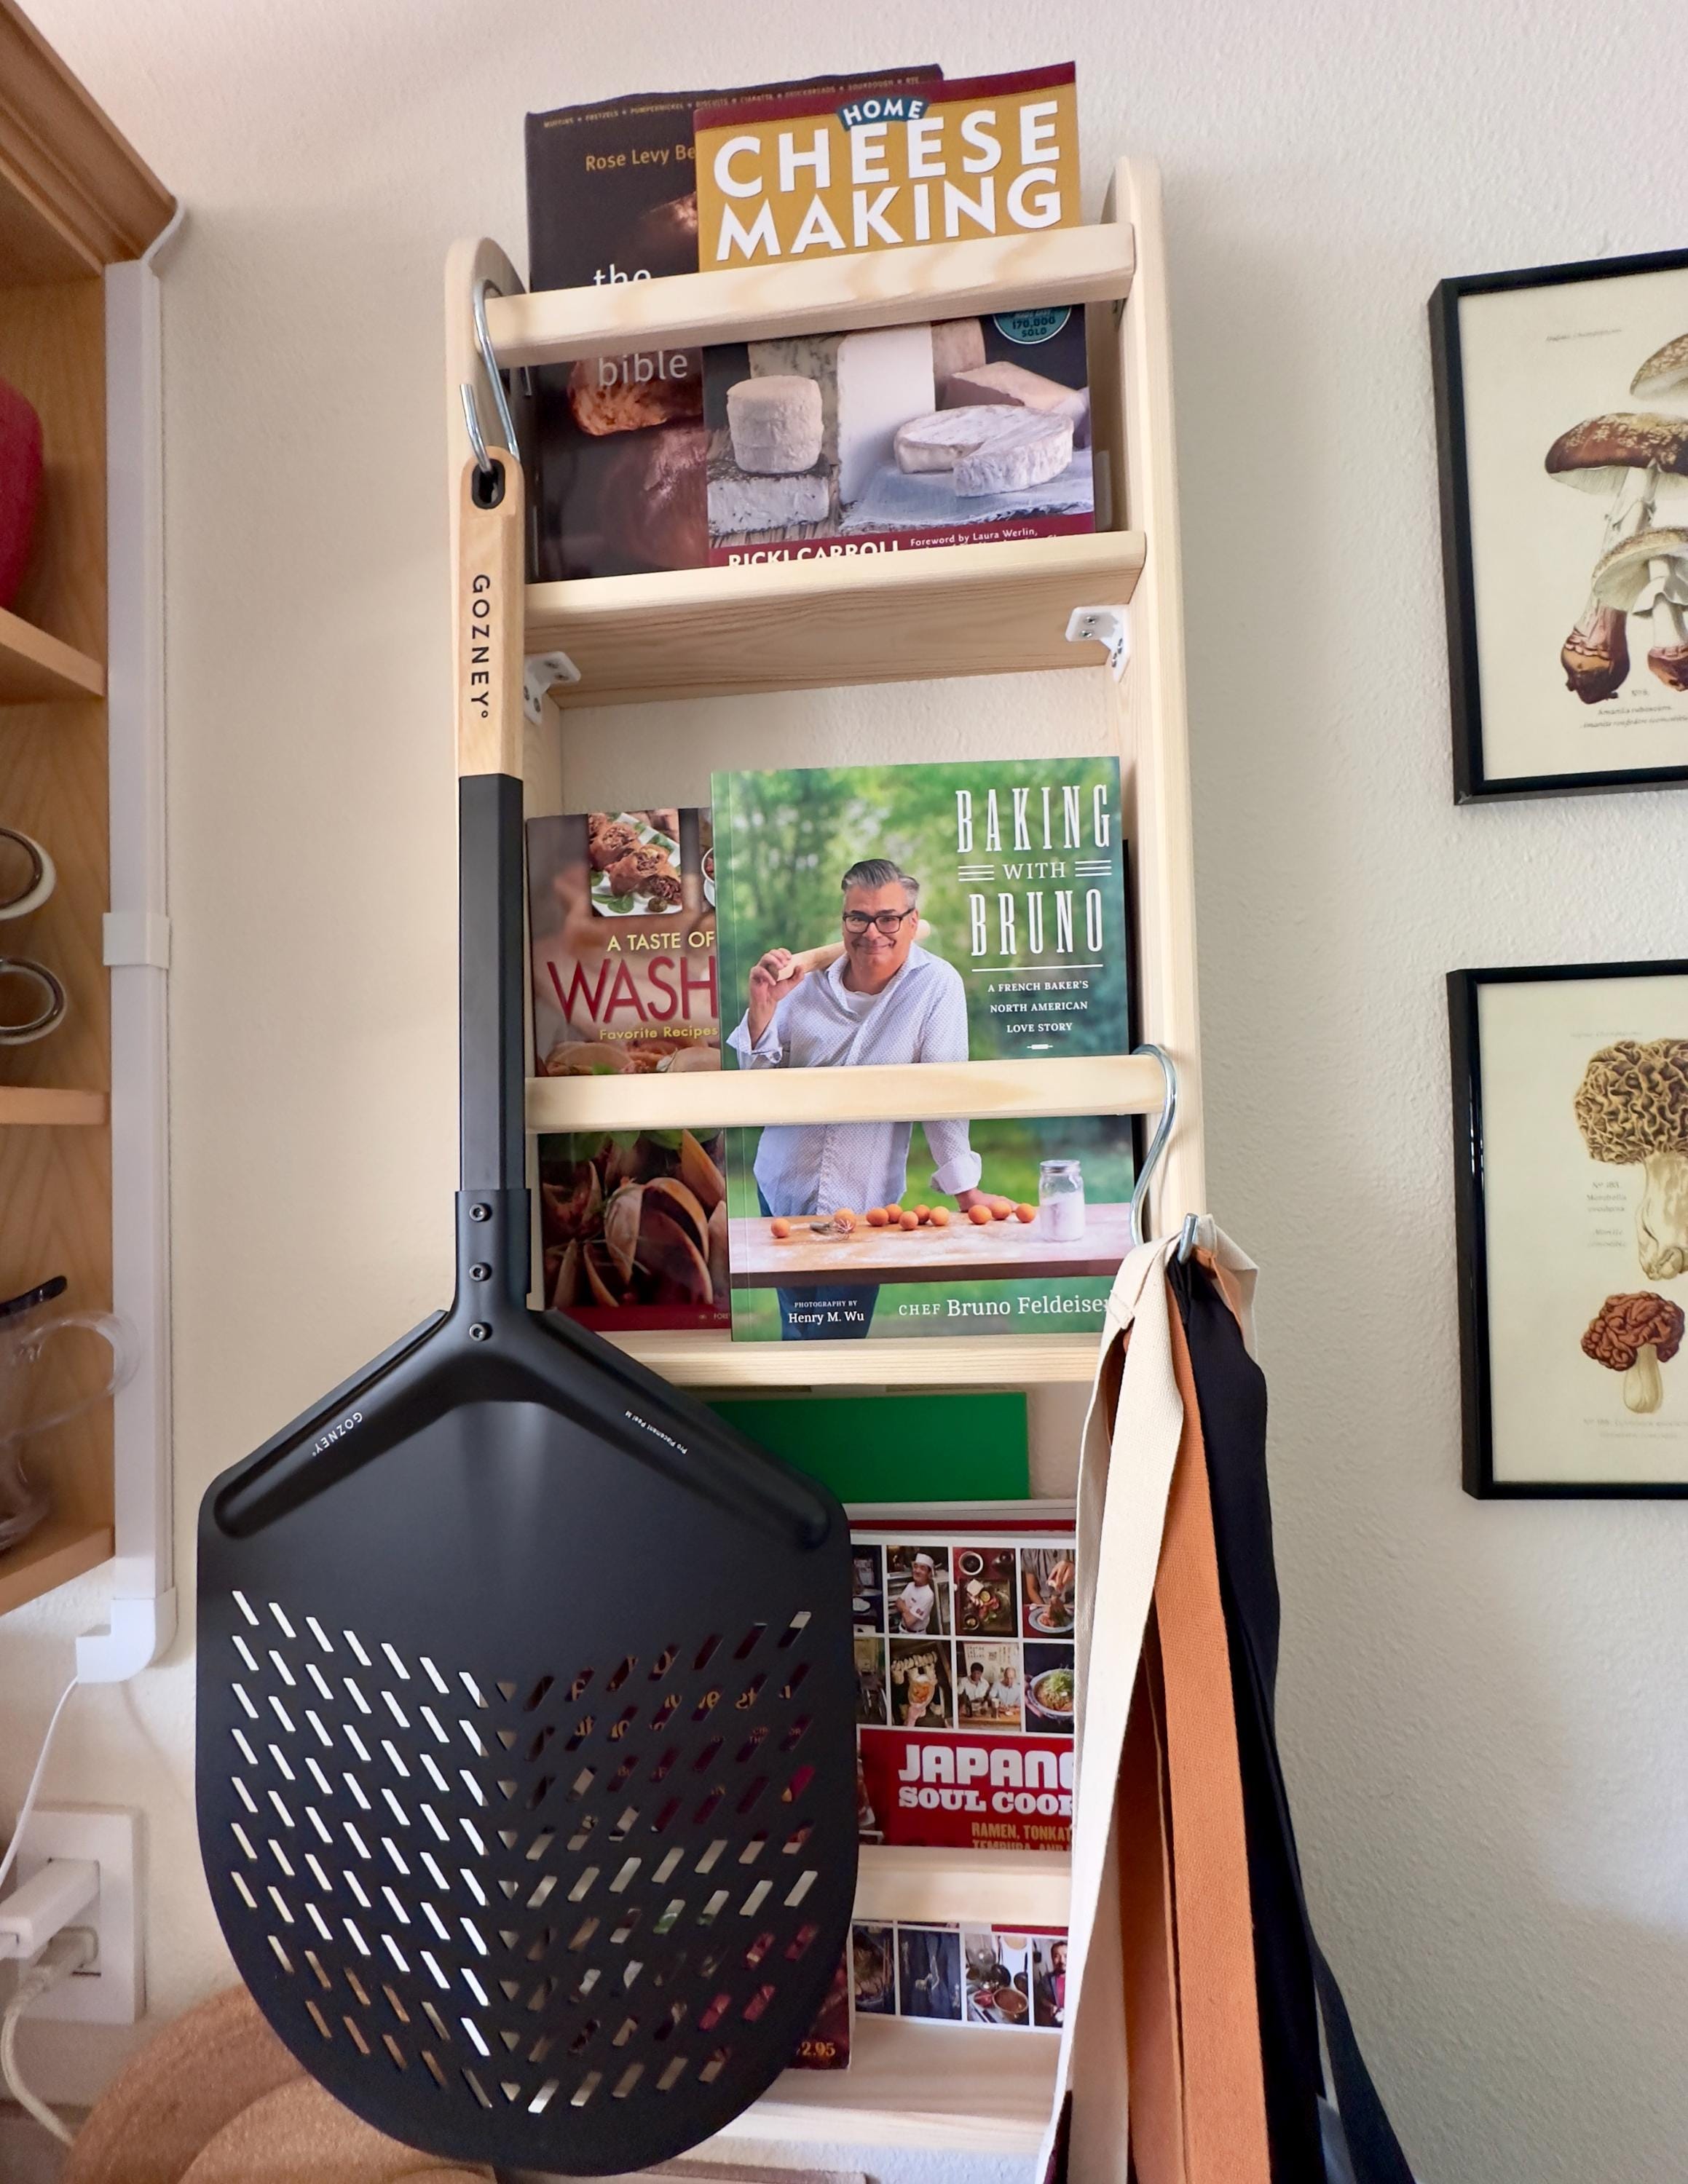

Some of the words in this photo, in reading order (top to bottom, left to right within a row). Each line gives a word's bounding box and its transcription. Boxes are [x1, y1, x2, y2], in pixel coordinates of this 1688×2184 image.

[843, 98, 923, 126] HOME
[713, 100, 1061, 199] CHEESE
[585, 154, 626, 172] Rose
[632, 148, 670, 165] Levy
[716, 167, 1062, 261] MAKING
[1012, 316, 1056, 330] 170,000
[1021, 327, 1047, 338] SOLD
[599, 350, 688, 387] bible
[910, 534, 955, 547] Foreword
[958, 534, 970, 543] by
[973, 531, 1000, 541] Laura
[1003, 528, 1038, 538] Werlin,
[955, 784, 1111, 853] BAKING
[1002, 861, 1066, 880] WITH
[969, 889, 1103, 957] BRUNO
[607, 935, 621, 952] A
[627, 932, 681, 951] TASTE
[688, 931, 716, 948] OF
[547, 955, 719, 1024] WASH
[987, 984, 995, 992] A
[998, 982, 1041, 992] FRENCH
[1044, 980, 1089, 990] BAKER'S
[990, 1003, 1028, 1013] NORTH
[1031, 1001, 1088, 1011] AMERICAN
[599, 1026, 658, 1040] Favorite
[663, 1025, 719, 1039] Recipes
[1006, 1024, 1035, 1033] LOVE
[1038, 1022, 1073, 1032] STORY
[794, 1300, 846, 1308] PHOTOGRAPHY
[899, 1303, 941, 1316] CHEF
[947, 1299, 1011, 1317] Bruno
[789, 1312, 824, 1325] Henry
[827, 1311, 842, 1322] M.
[844, 1310, 865, 1321] Wu
[625, 1410, 633, 1418] M
[631, 1415, 647, 1428] Peel
[647, 1424, 677, 1447] Placement
[677, 1444, 688, 1455] Pro
[899, 1786, 987, 1813] SOUL
